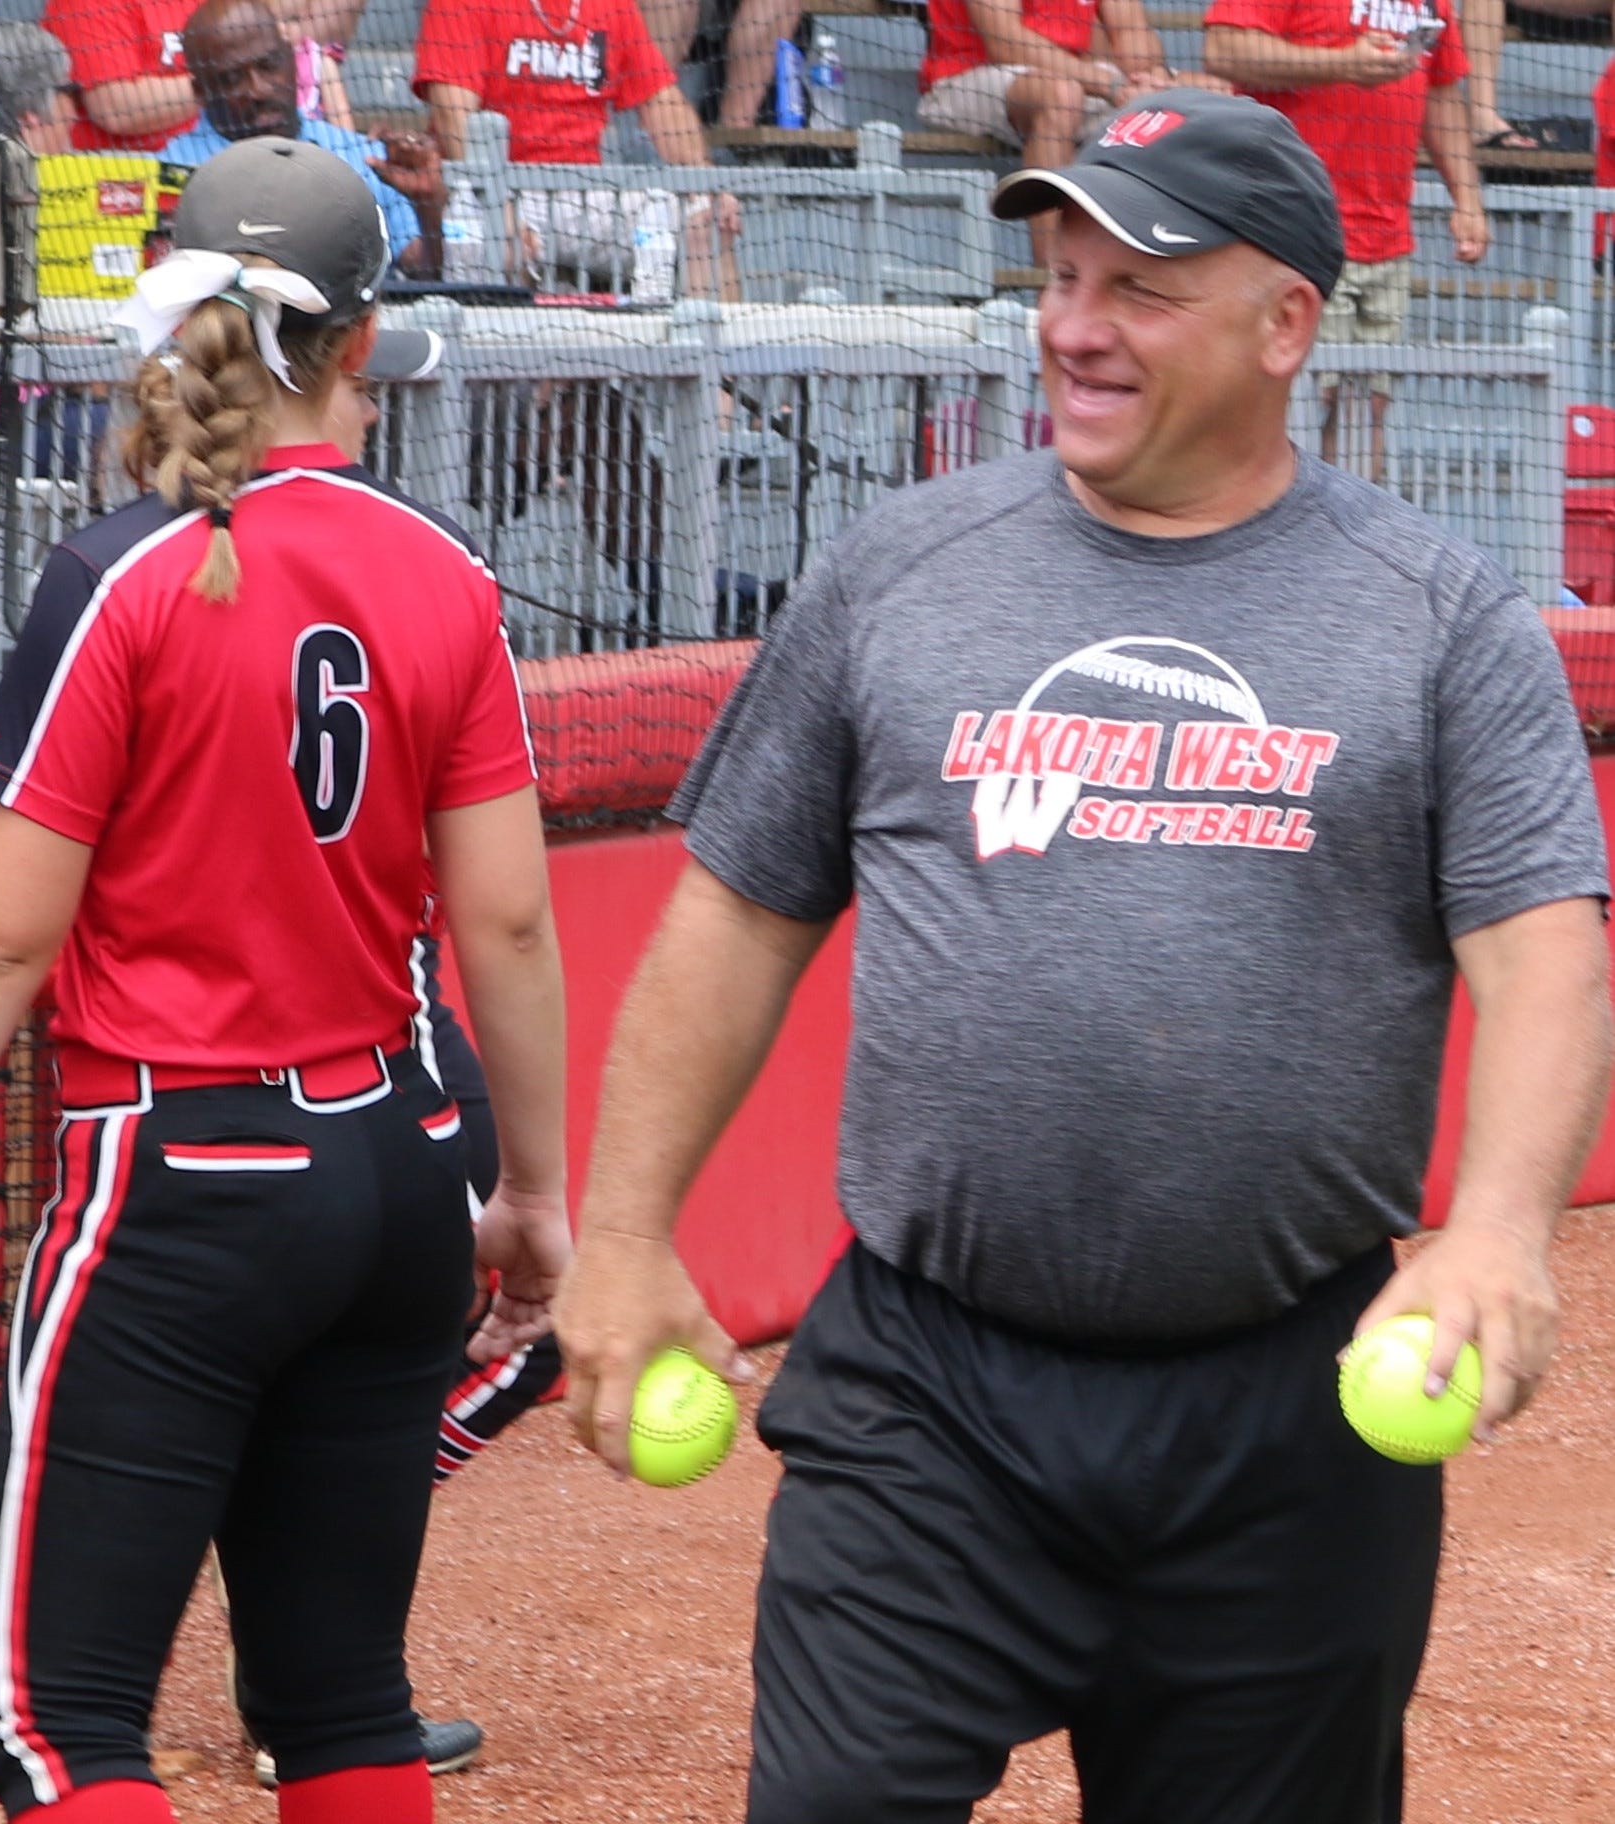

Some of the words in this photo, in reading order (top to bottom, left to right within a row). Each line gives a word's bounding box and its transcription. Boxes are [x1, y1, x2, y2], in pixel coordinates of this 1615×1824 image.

[288, 622, 370, 844] 6
[941, 710, 1164, 790] LAKOTA
[1165, 721, 1340, 796] WEST
[969, 770, 1083, 862] W
[1067, 796, 1317, 852] SOFTBALL
